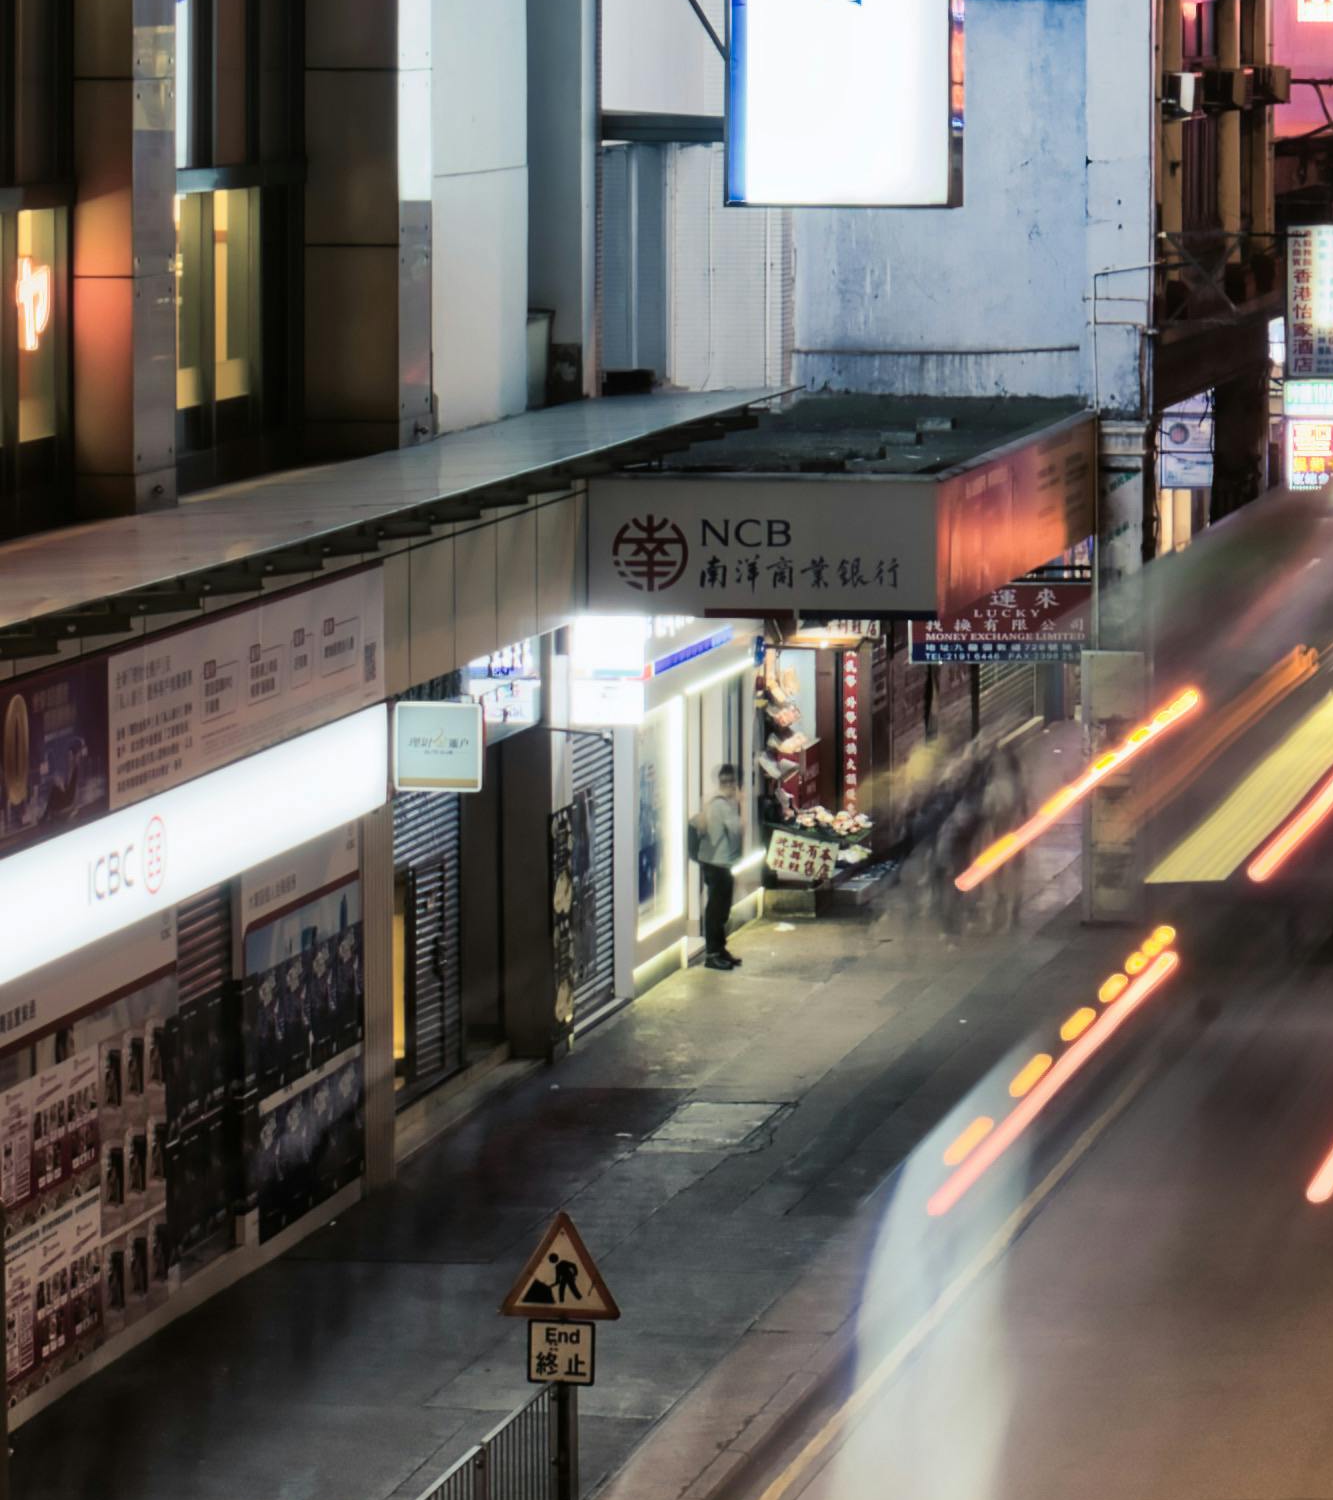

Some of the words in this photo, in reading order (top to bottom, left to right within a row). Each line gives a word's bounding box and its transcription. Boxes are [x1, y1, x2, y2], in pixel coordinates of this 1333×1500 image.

[1293, 269, 1313, 374] 香港怡家酒店
[700, 518, 793, 548] NCB
[699, 553, 900, 594] 南洋商業銀行
[973, 609, 1041, 618] LUCKY
[925, 632, 968, 641] MONEY
[970, 632, 1034, 641] EXCHANGE
[1035, 632, 1086, 641] LIMITED
[87, 845, 135, 904] ICBC
[545, 1327, 581, 1345] End
[536, 1352, 587, 1377] 終止
